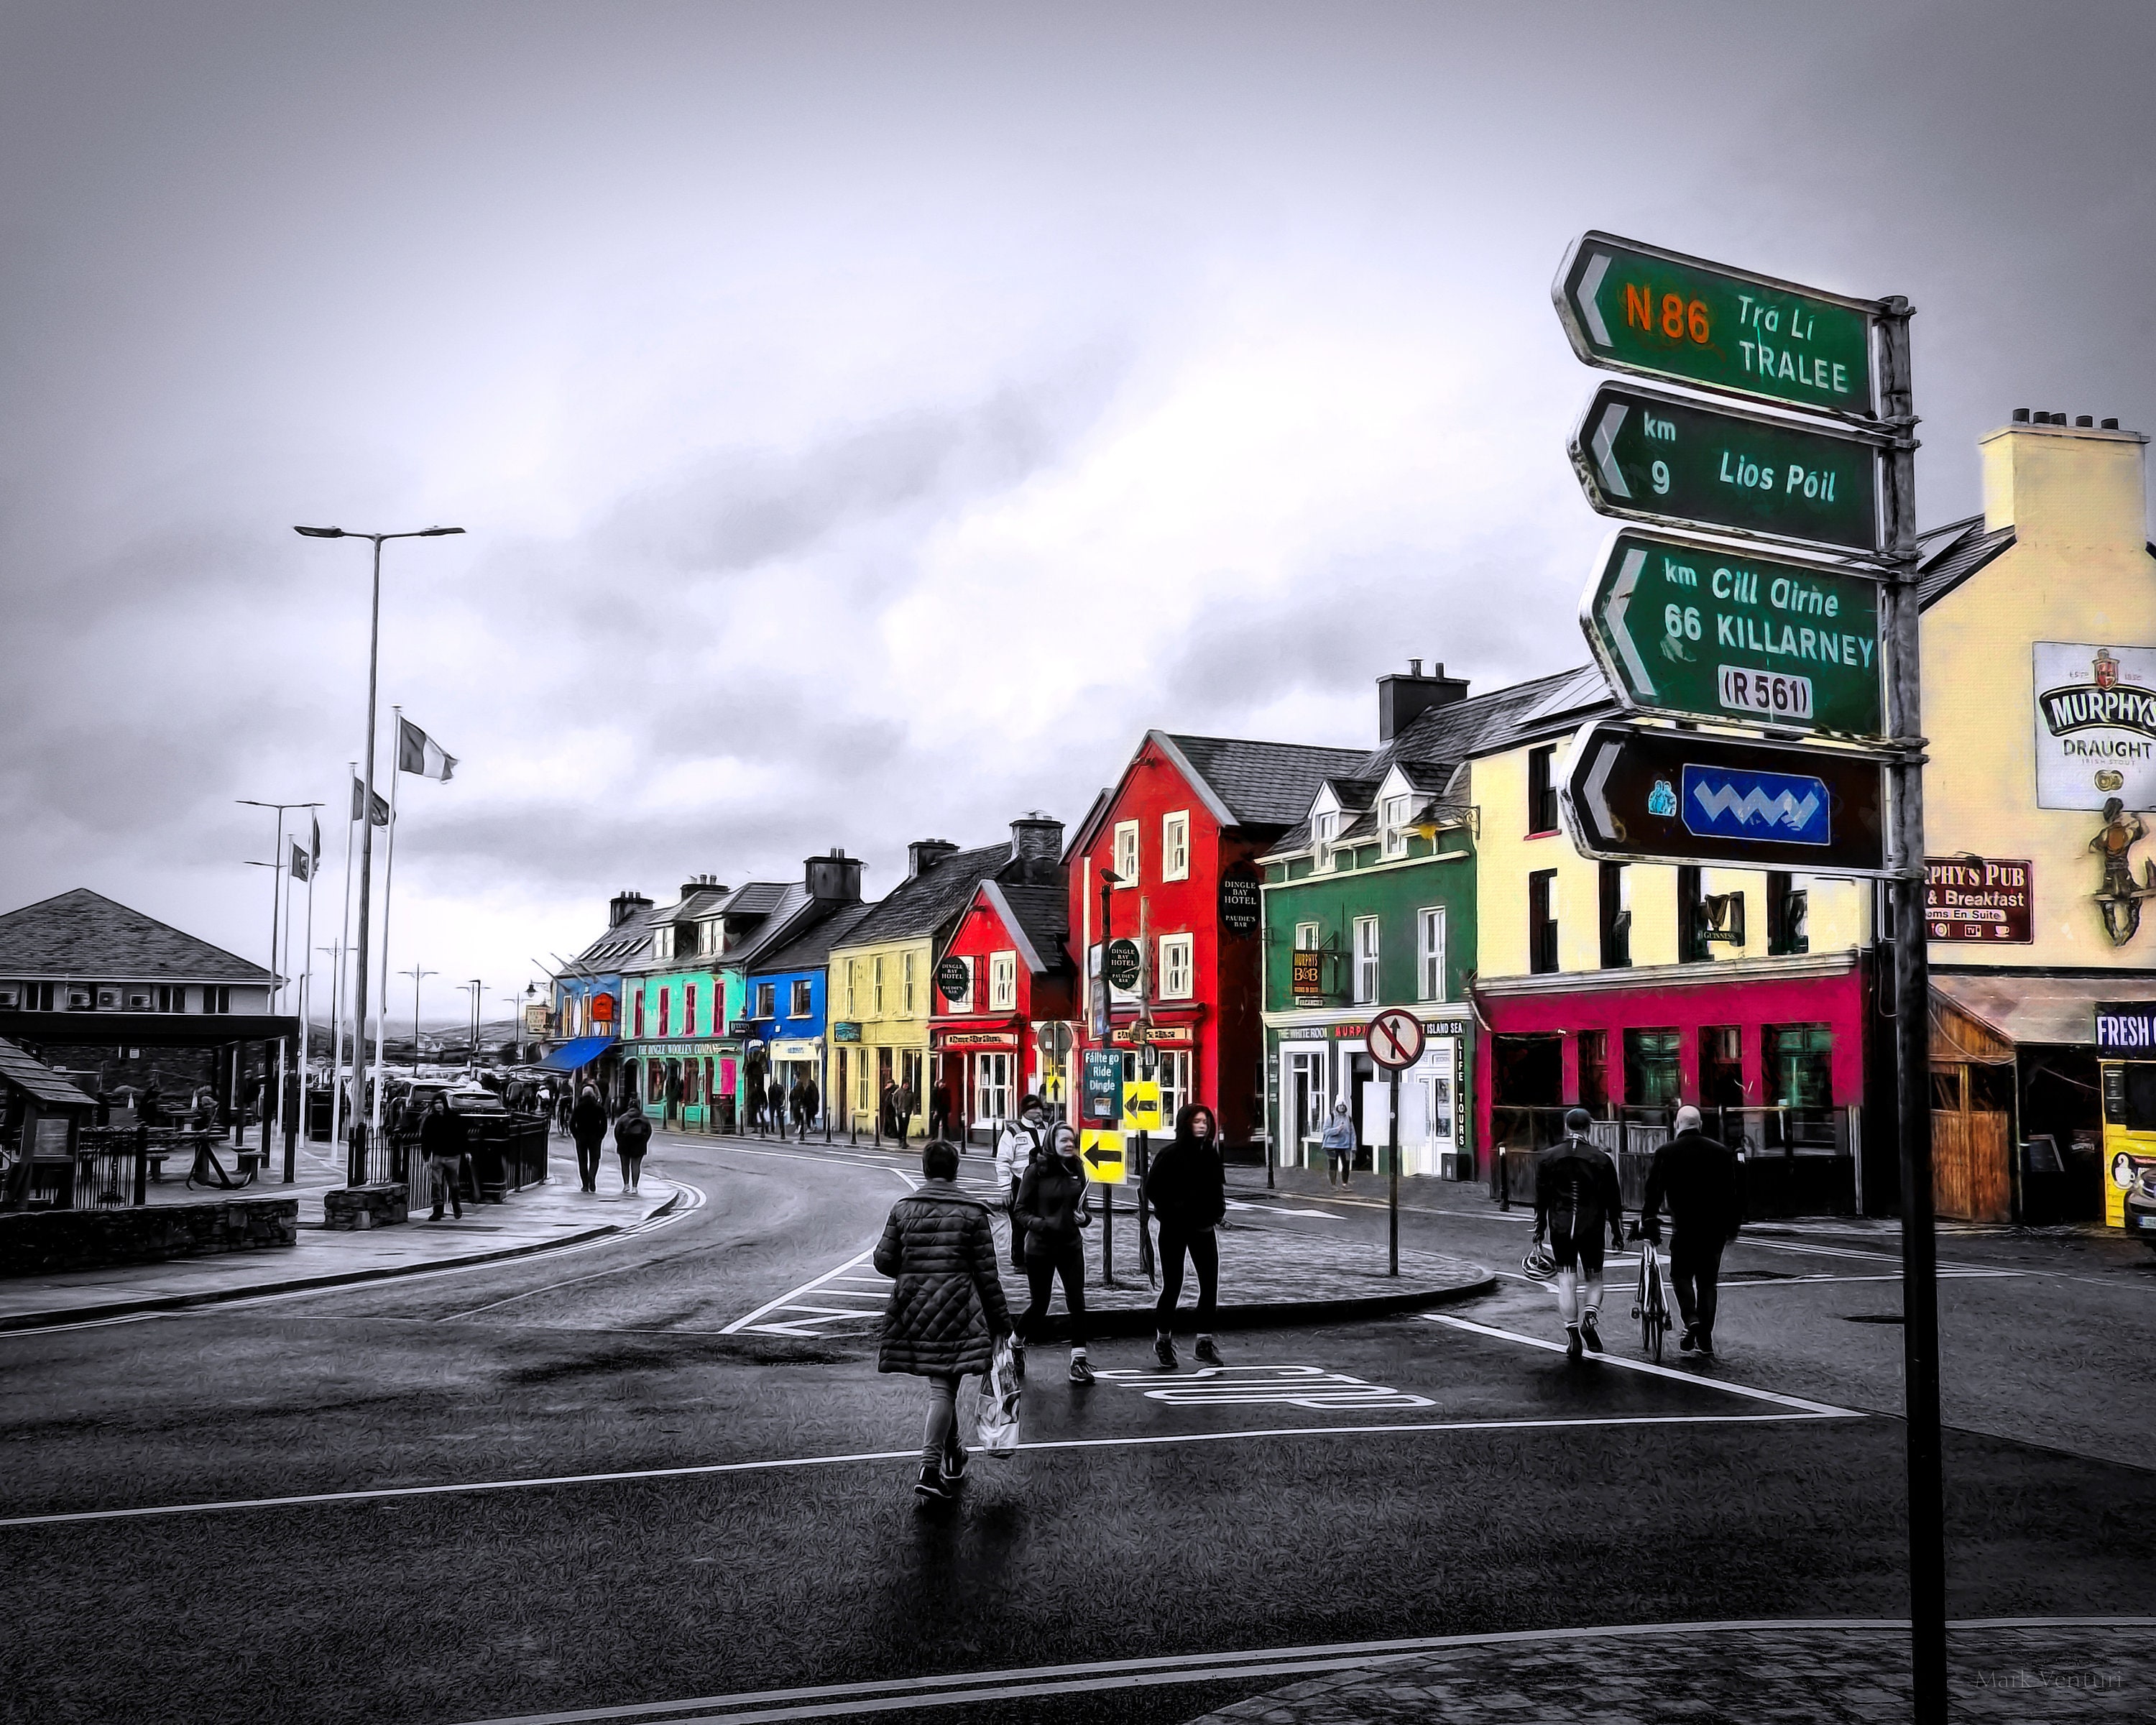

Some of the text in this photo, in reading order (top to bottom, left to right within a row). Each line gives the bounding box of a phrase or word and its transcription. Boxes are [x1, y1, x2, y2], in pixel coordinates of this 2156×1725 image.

[1626, 283, 1709, 344] N 86
[1738, 295, 1815, 341] Trá Lí
[1739, 341, 1848, 394] TRALEE
[1644, 412, 1676, 441] km
[1652, 460, 1669, 494] 9
[1720, 451, 1835, 502] Lios Póil
[1664, 558, 1697, 587] km
[1712, 568, 1757, 605] Cill
[1664, 604, 1874, 668] 66 KILLARNEY
[1724, 671, 1807, 713] (R 561)
[2050, 692, 2156, 728] MURPHY'S
[2063, 740, 2152, 759] DRAUGHT
[1225, 880, 1256, 889] DINGLE
[1986, 864, 2025, 887] PUB
[1225, 896, 1256, 905] HOTEL
[1927, 889, 2024, 907] & Breakfast
[1953, 910, 1967, 919] En
[1972, 910, 2001, 919] Suite
[1703, 931, 1736, 939] GUINNESS
[1294, 967, 1318, 981] B&B
[1427, 1023, 1449, 1034] ISLAND
[1450, 1022, 1463, 1034] SEA
[2096, 1016, 2150, 1046] FRESH
[1093, 1065, 1112, 1077] Ride
[1109, 1054, 1119, 1065] go
[1089, 1080, 1115, 1092] Dingle
